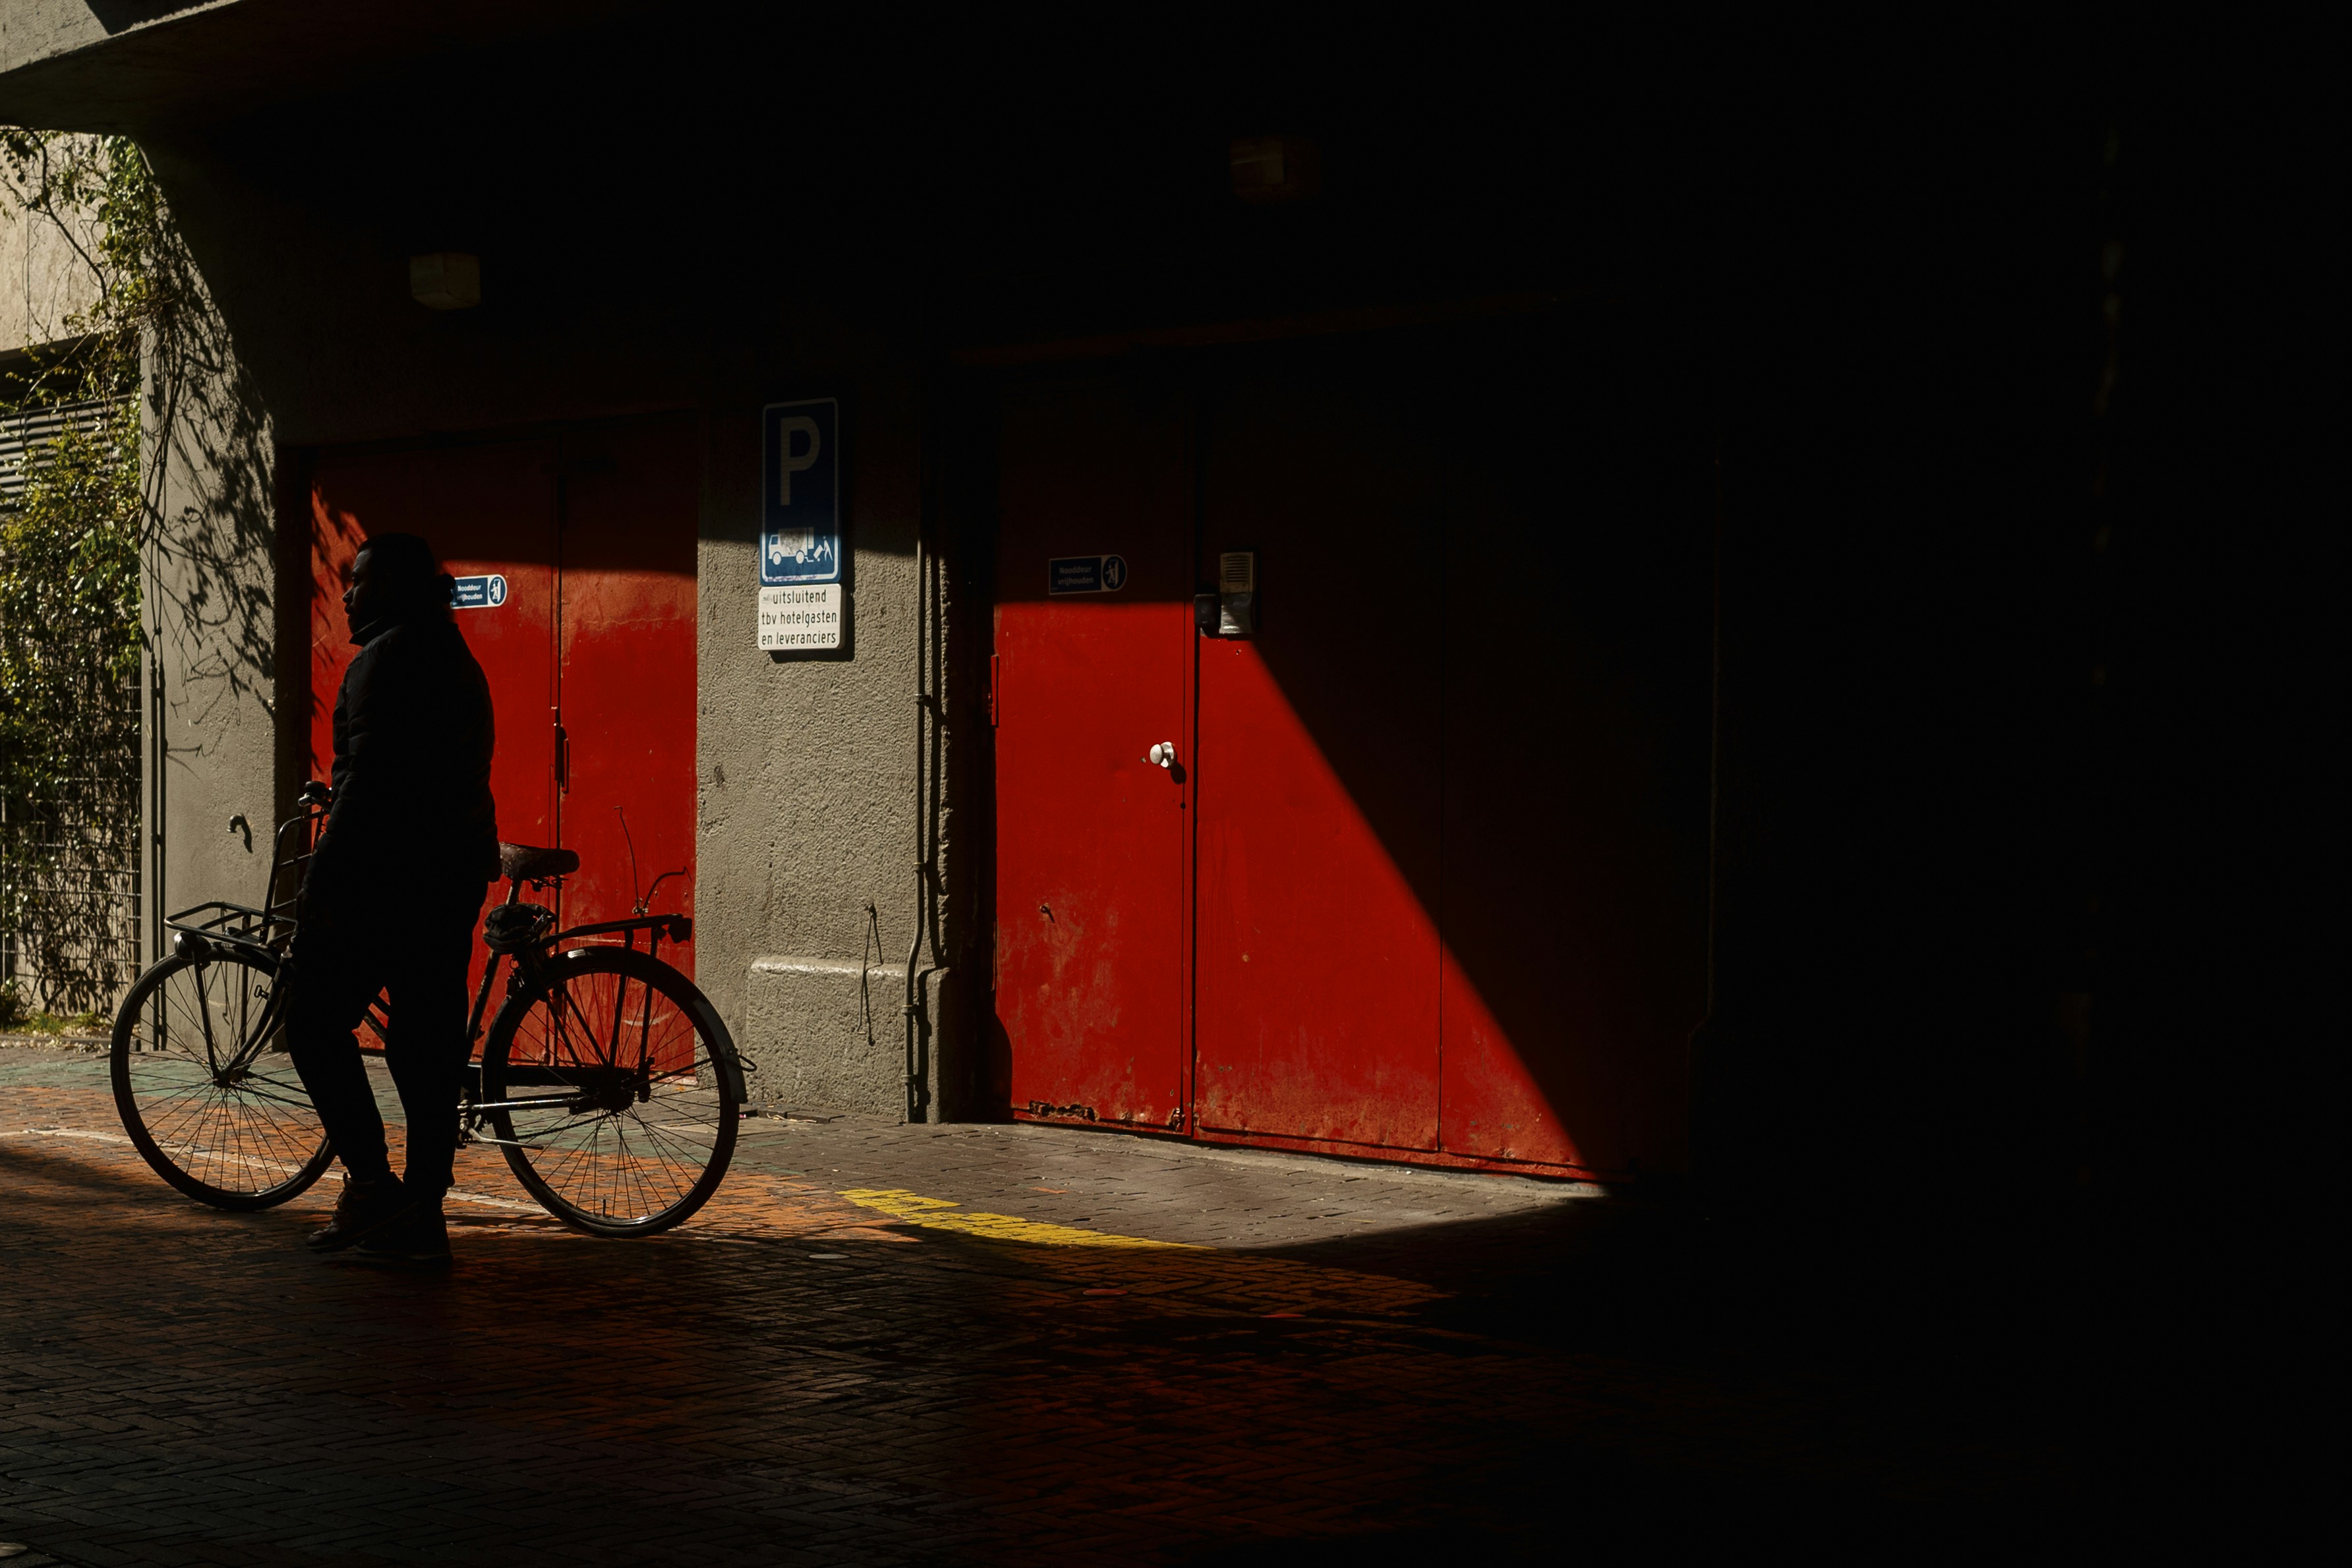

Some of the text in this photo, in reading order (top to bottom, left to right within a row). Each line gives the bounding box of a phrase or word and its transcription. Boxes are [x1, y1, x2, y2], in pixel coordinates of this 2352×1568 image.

[780, 415, 821, 506] P
[1059, 566, 1092, 575] Nooddeur
[1057, 576, 1094, 587] vrijhouden
[773, 589, 827, 604] uitsluitend
[761, 610, 837, 628] tbv hotelgasten
[761, 630, 836, 645] en leveranciers
